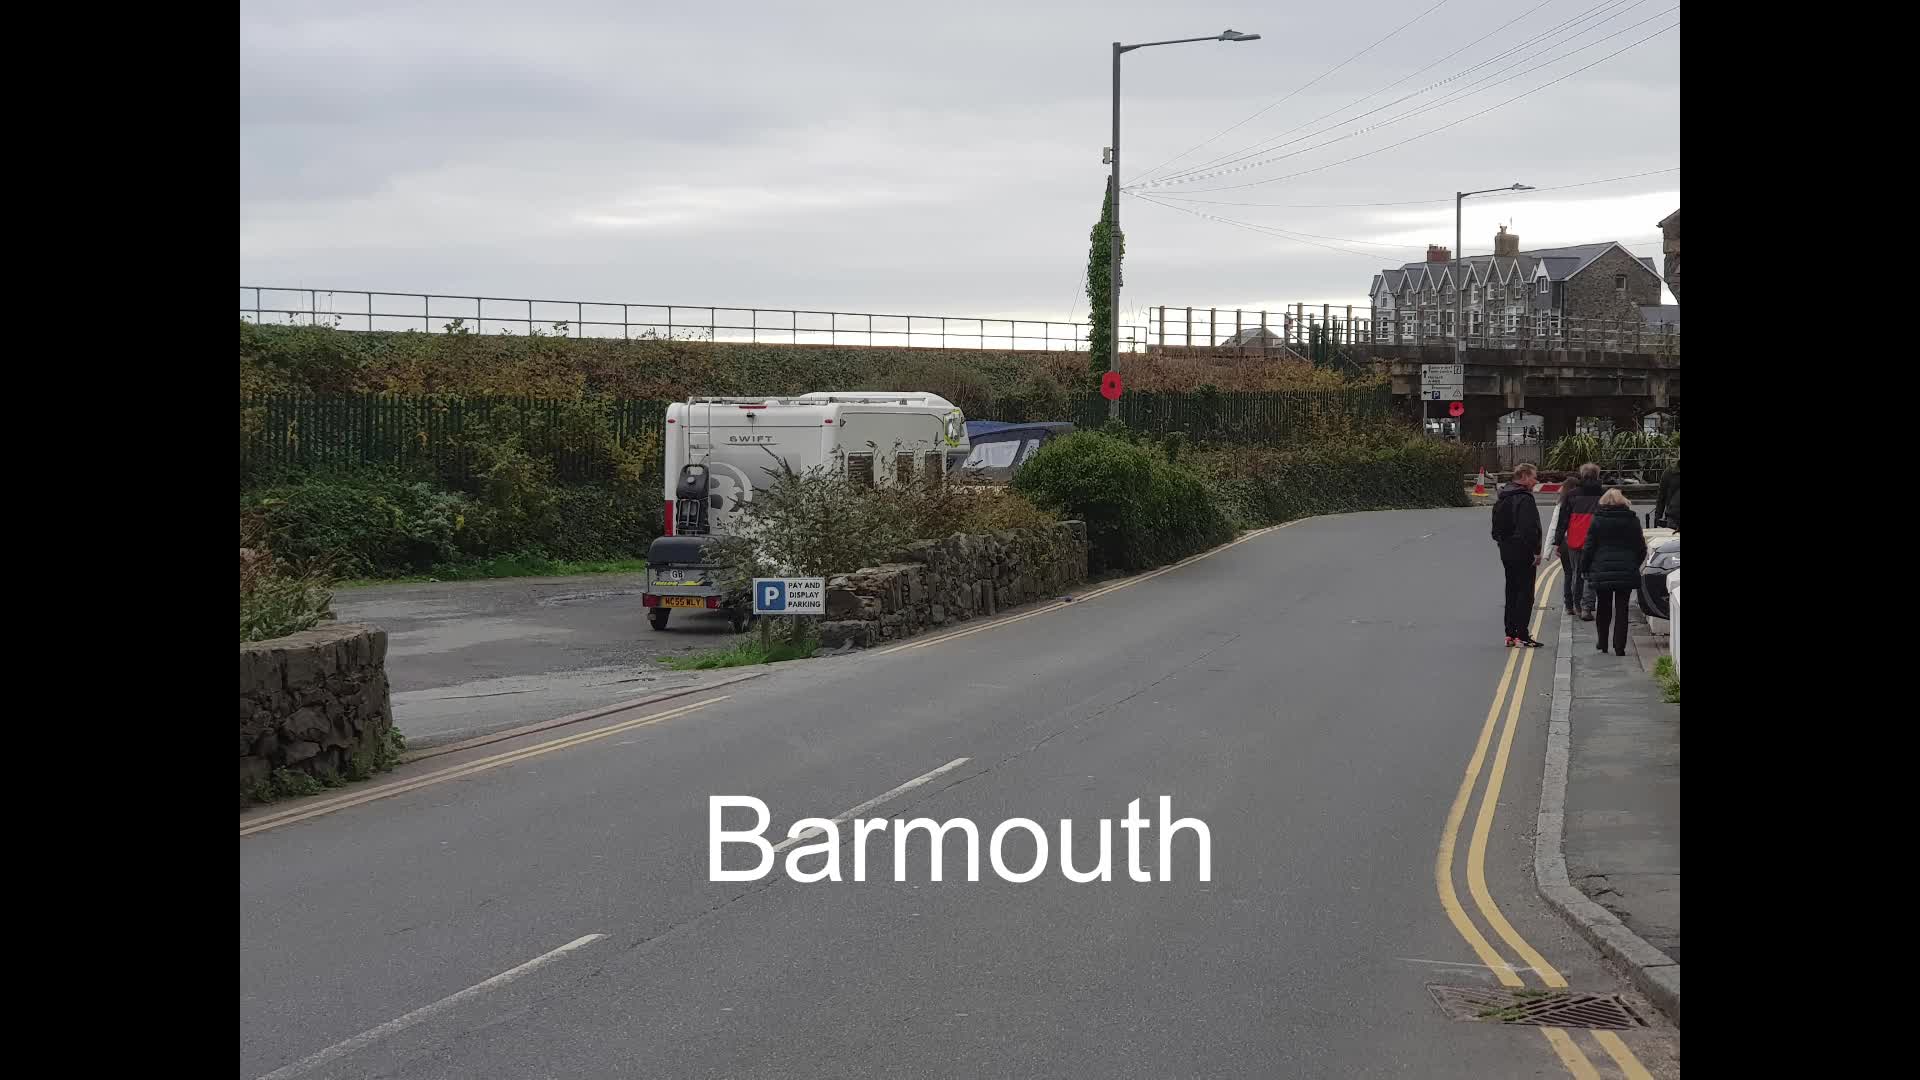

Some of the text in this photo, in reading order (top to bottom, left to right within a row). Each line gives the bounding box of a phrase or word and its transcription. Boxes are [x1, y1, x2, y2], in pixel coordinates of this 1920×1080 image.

[729, 435, 774, 443] SWIFT
[671, 570, 684, 579] GB
[764, 586, 780, 606] P
[789, 591, 820, 599] DISPLAY
